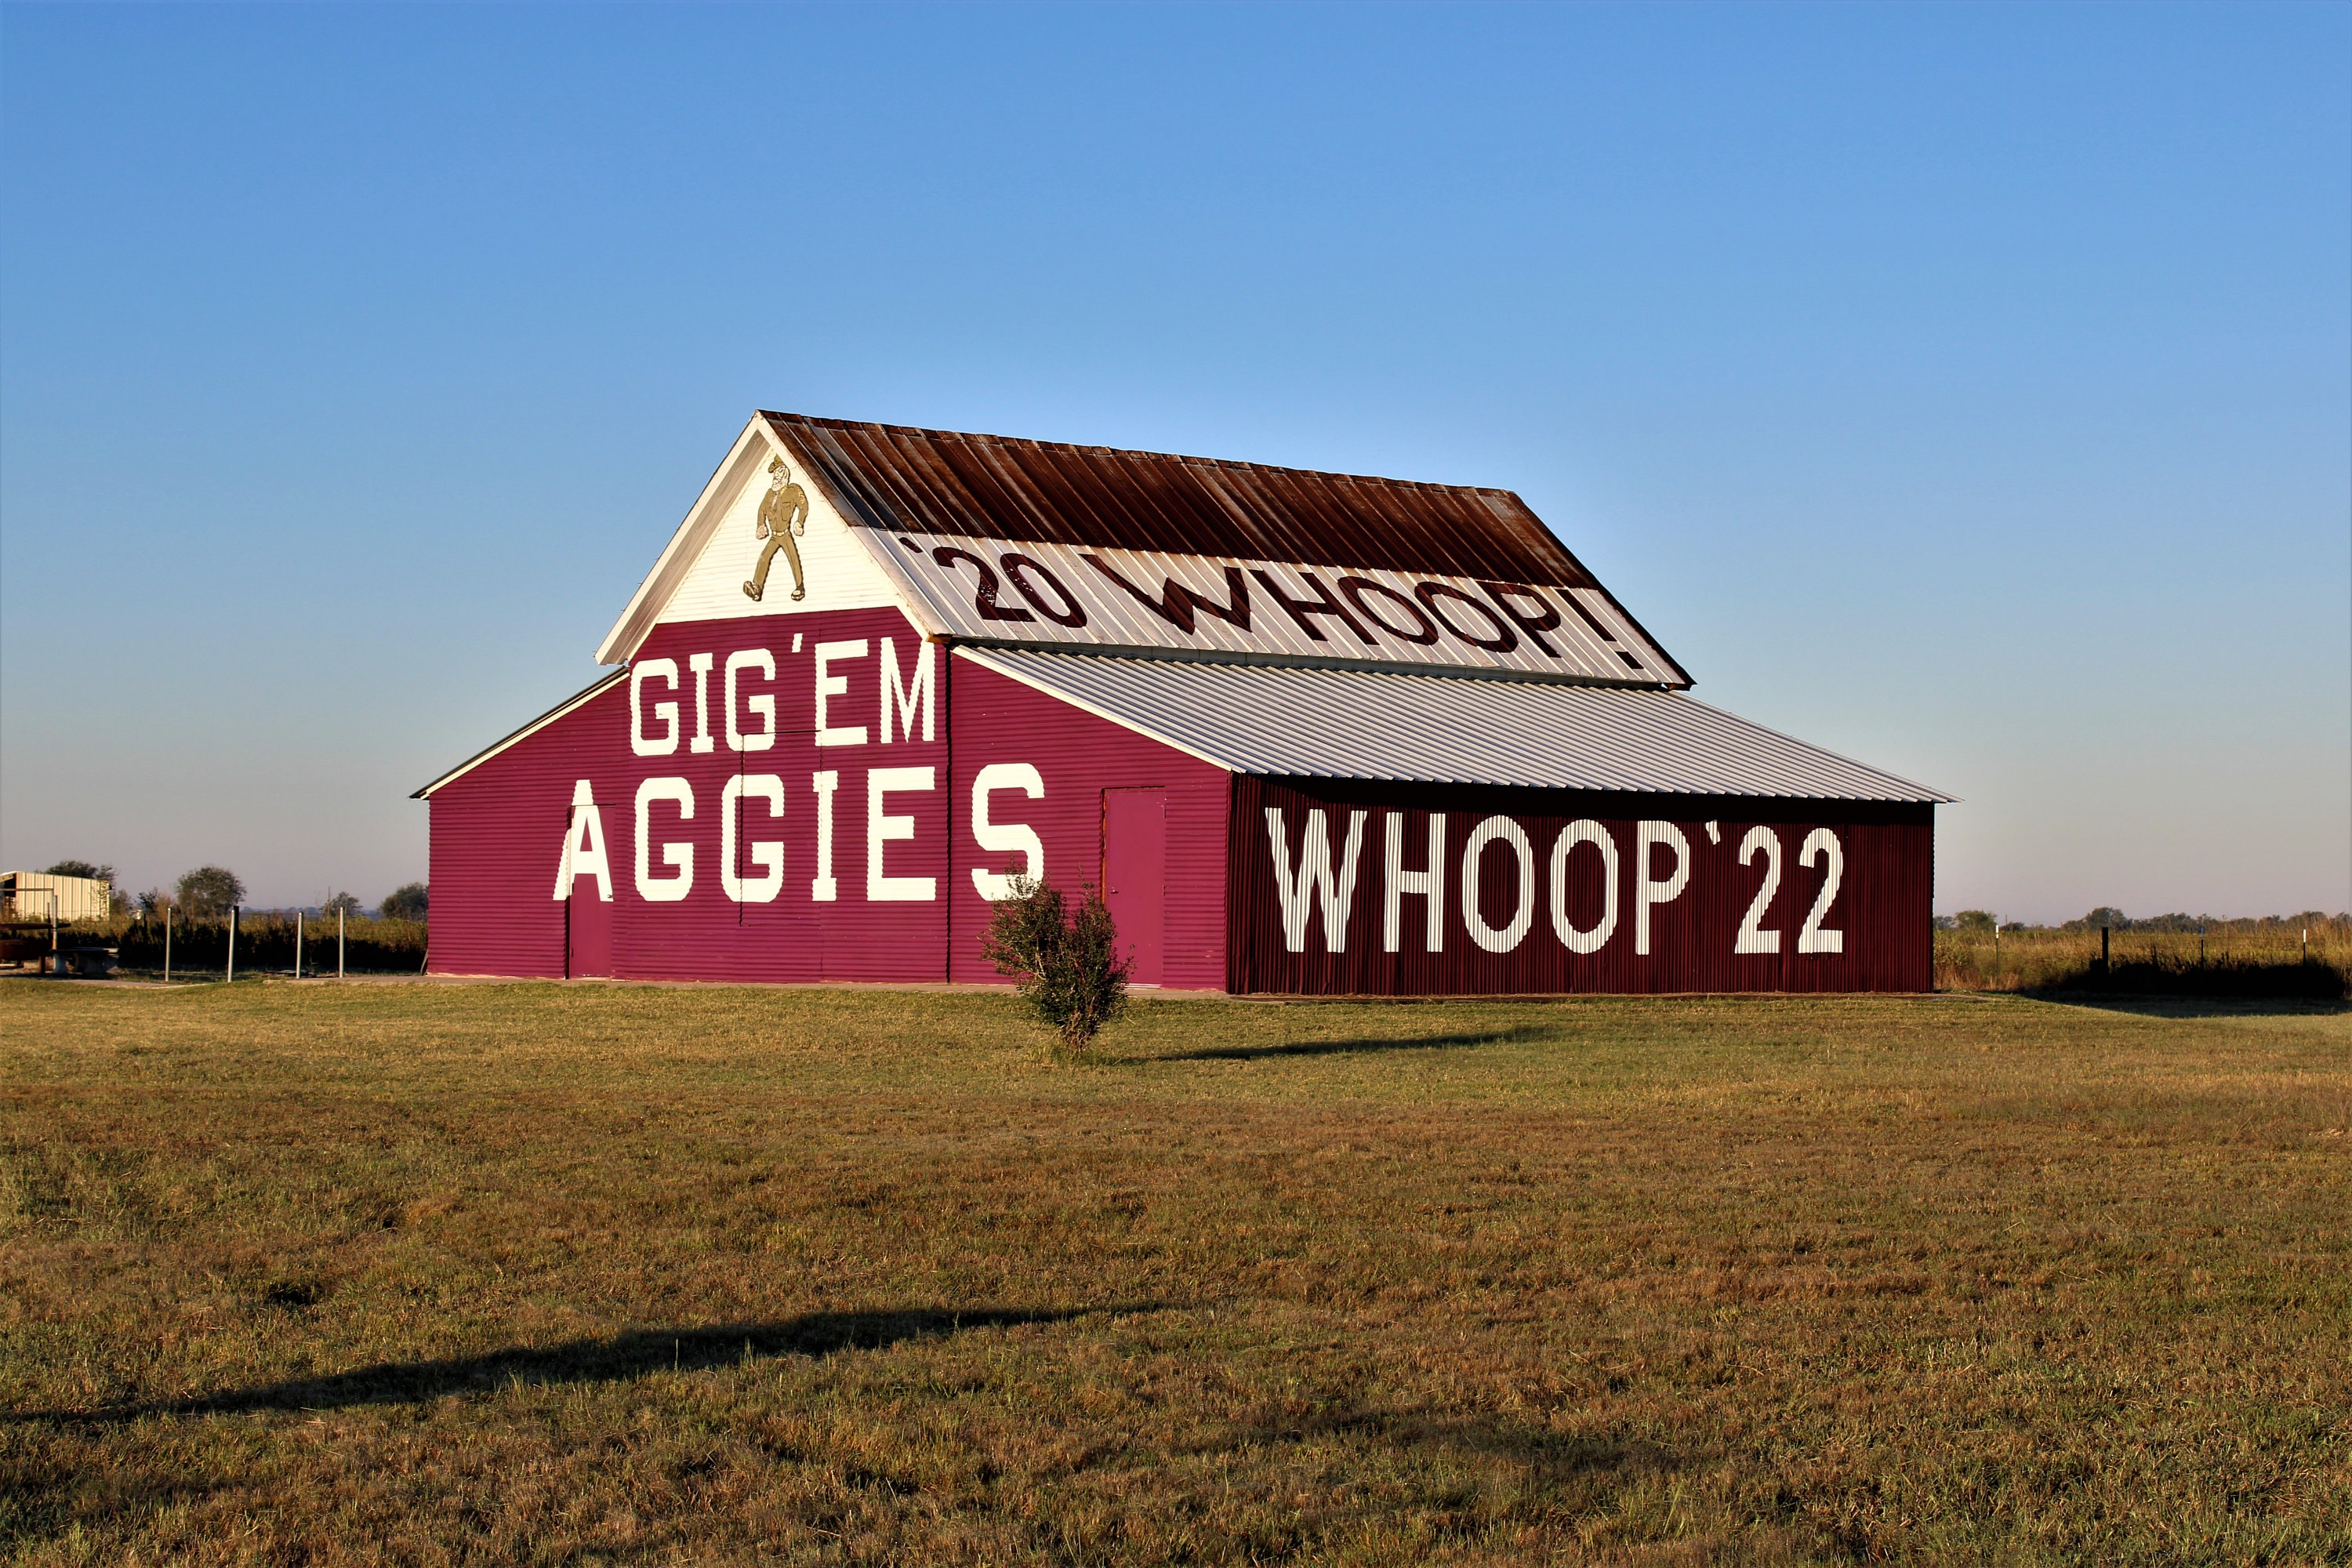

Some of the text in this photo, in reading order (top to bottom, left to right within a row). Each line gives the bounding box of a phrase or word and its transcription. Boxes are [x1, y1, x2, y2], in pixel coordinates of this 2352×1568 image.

[1080, 554, 1644, 670] WHOOP!
[630, 648, 776, 757] GIG
[553, 762, 1045, 903] AGGIES
[1265, 807, 1690, 956] WHOOP
